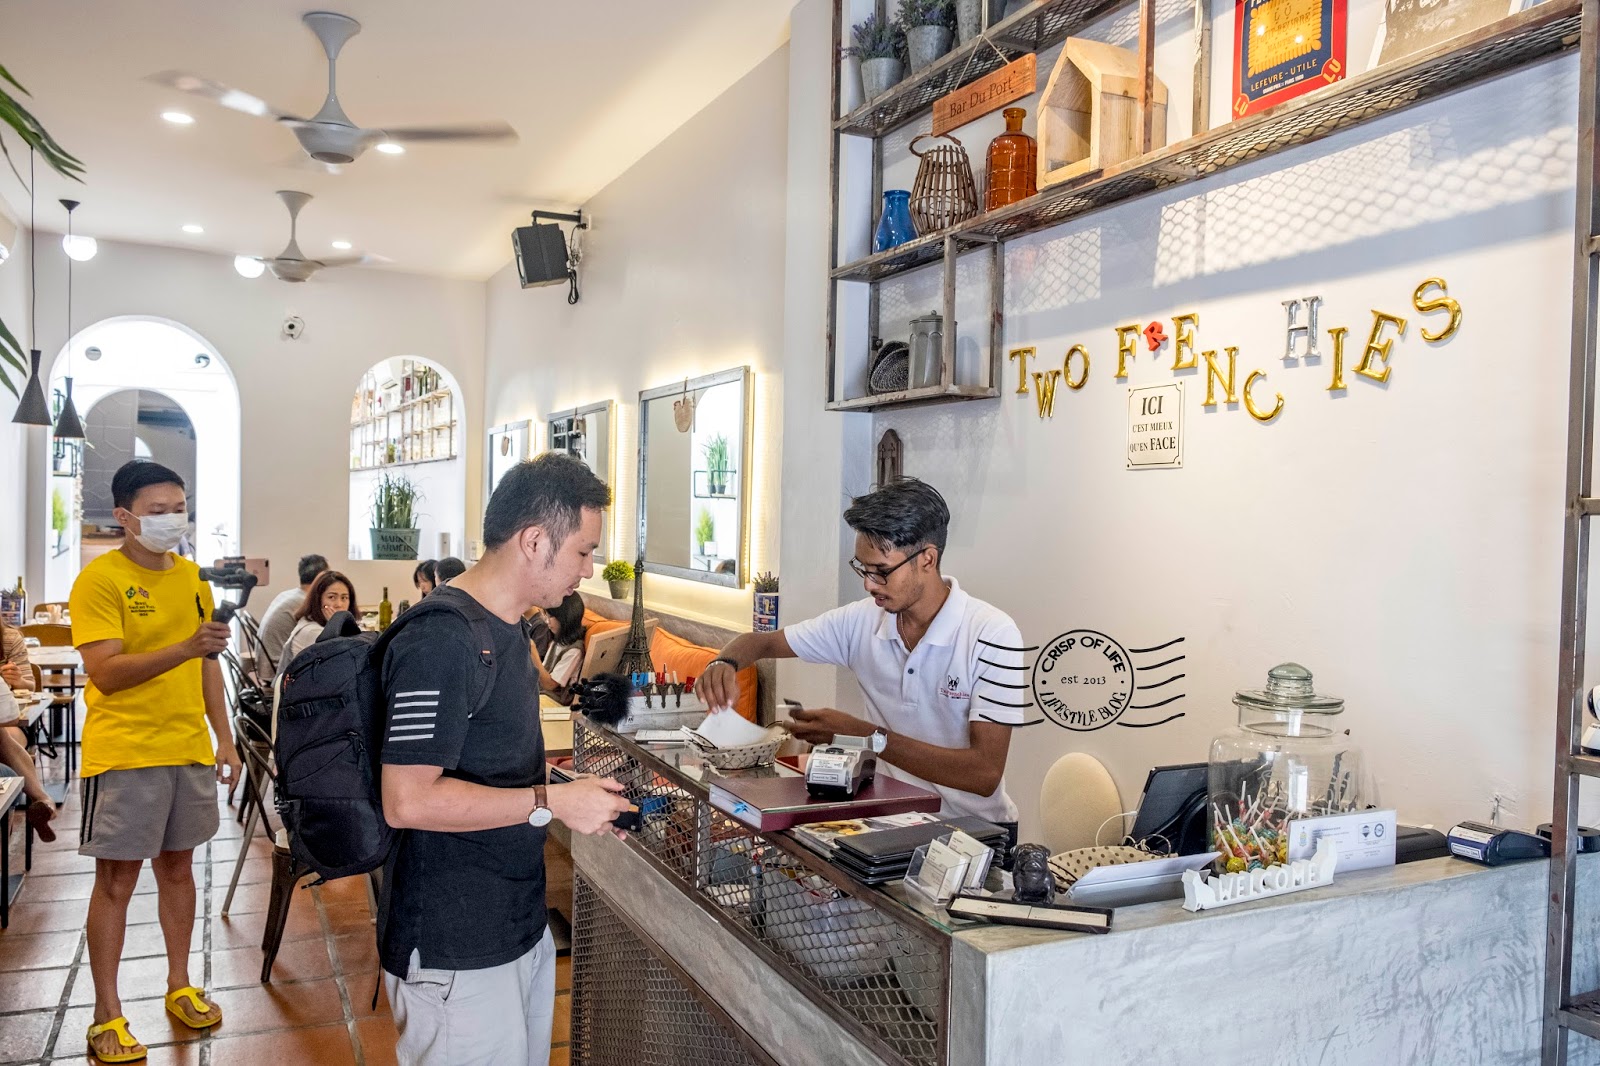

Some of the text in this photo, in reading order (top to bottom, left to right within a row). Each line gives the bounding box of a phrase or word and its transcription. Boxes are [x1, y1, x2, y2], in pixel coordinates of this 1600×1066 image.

[1290, 58, 1317, 75] UTILE
[1323, 58, 1341, 83] LU
[950, 76, 1012, 117] Bar Du Port
[1234, 97, 1248, 116] LU
[1009, 343, 1091, 418] TWO
[1141, 395, 1163, 416] ICI
[1132, 421, 1173, 433] C'EST MIEUX
[1150, 436, 1176, 450] FACE
[1218, 862, 1317, 902] WELCOME
